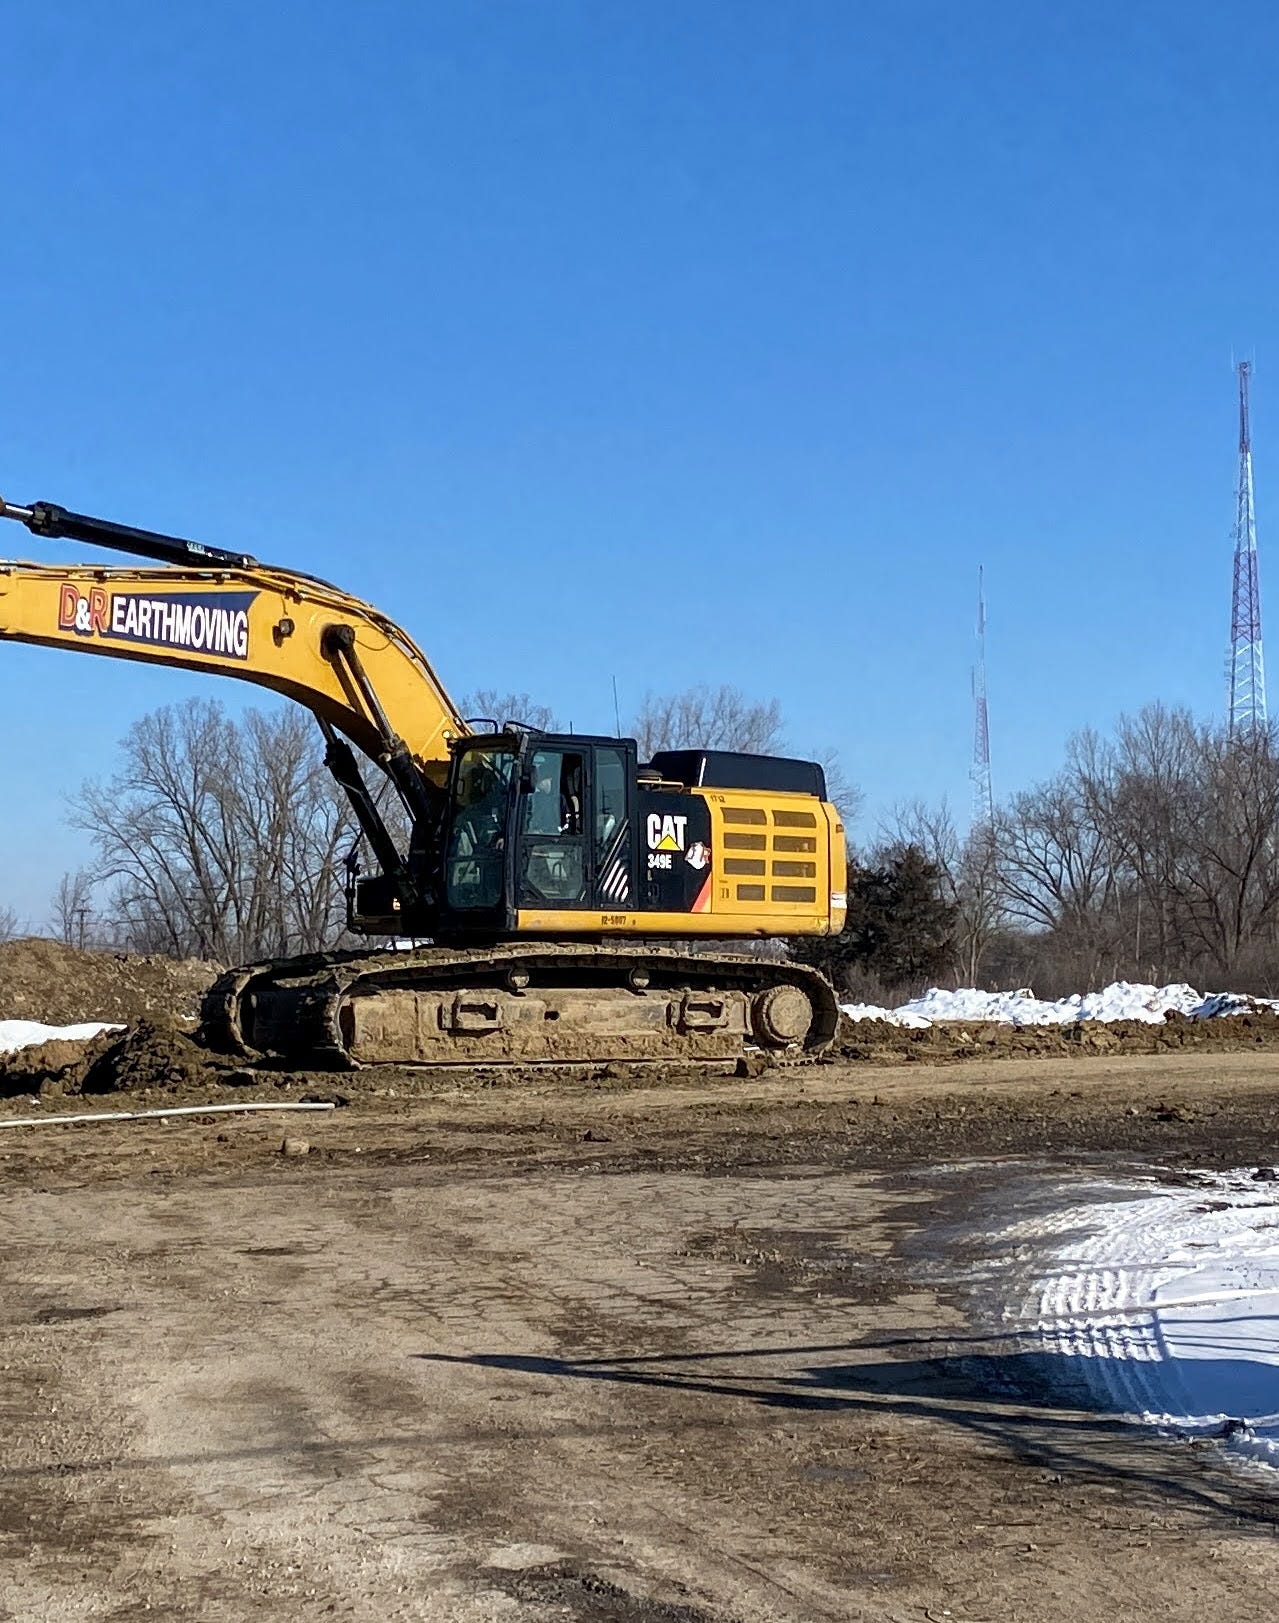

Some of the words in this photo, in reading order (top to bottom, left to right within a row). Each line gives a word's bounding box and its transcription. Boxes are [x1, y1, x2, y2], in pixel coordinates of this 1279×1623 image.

[59, 583, 108, 633] D&R
[112, 596, 247, 656] EARTHMOVING
[647, 813, 687, 851] CAT
[648, 853, 672, 869] 349E
